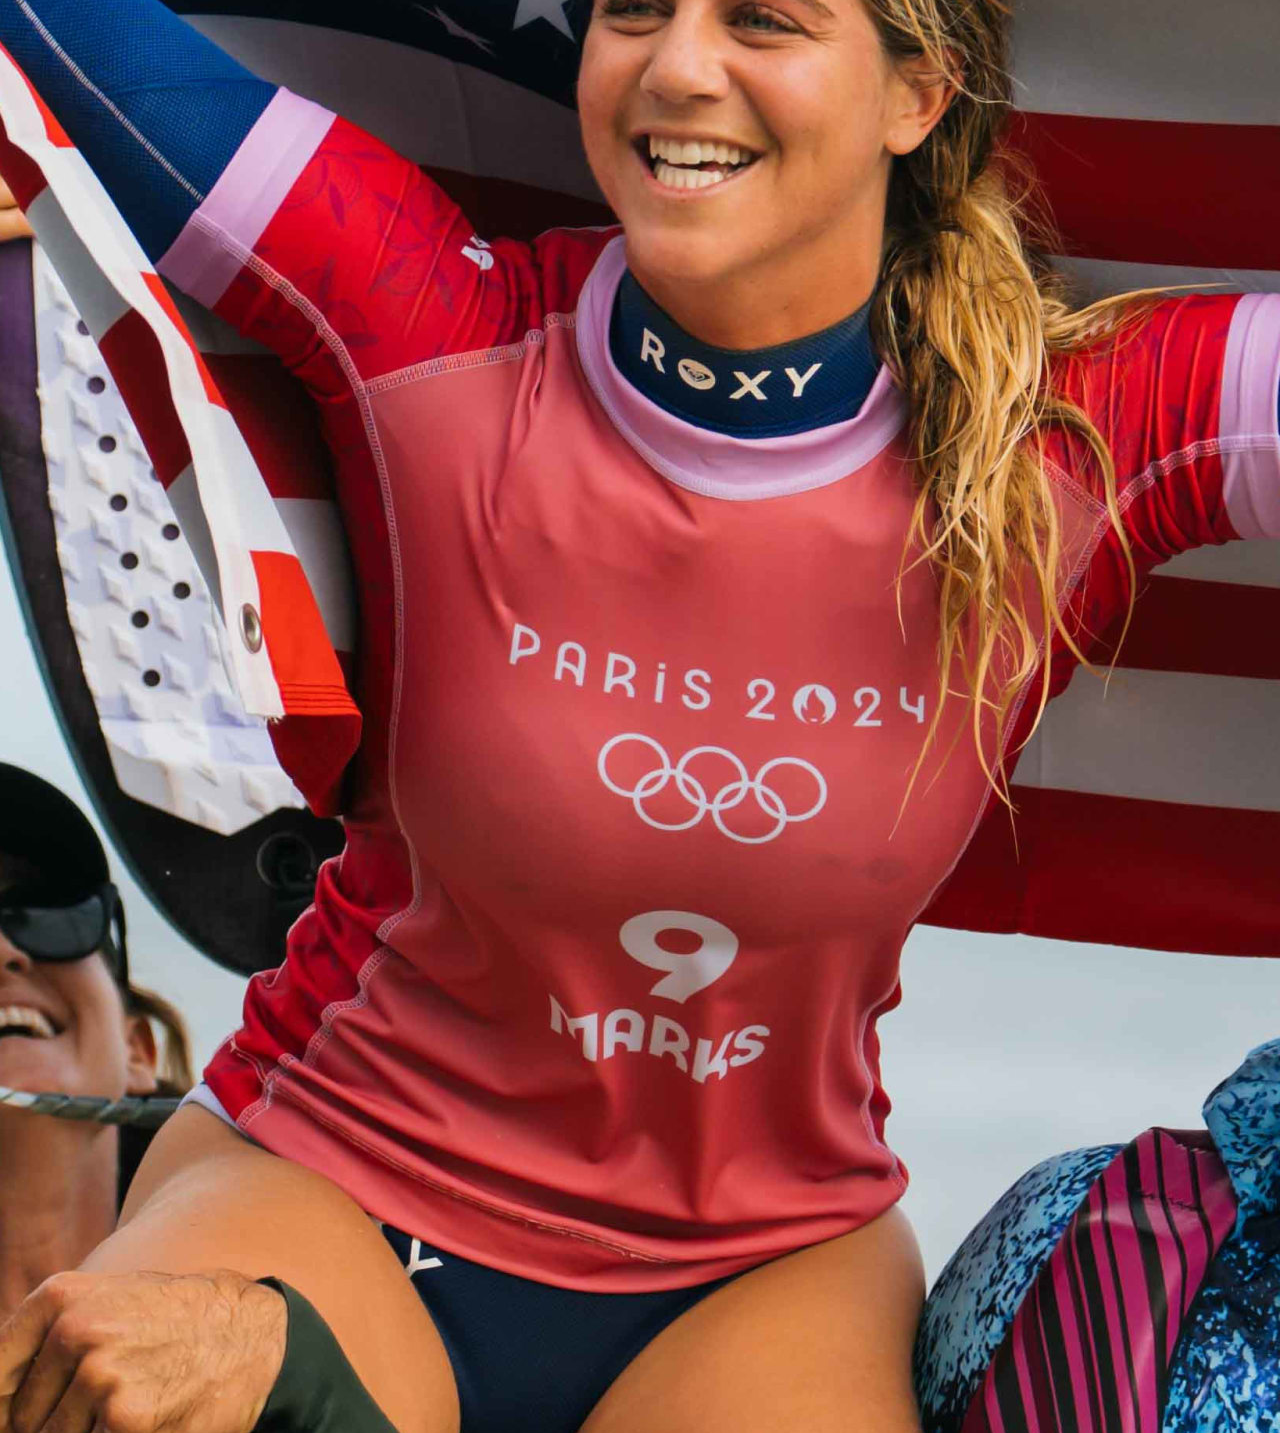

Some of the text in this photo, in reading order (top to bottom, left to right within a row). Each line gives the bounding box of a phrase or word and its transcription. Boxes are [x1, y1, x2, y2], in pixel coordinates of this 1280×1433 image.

[640, 327, 823, 401] ROXY
[745, 678, 926, 727] 2024
[619, 909, 740, 1004] 9
[549, 993, 770, 1084] MARKS
